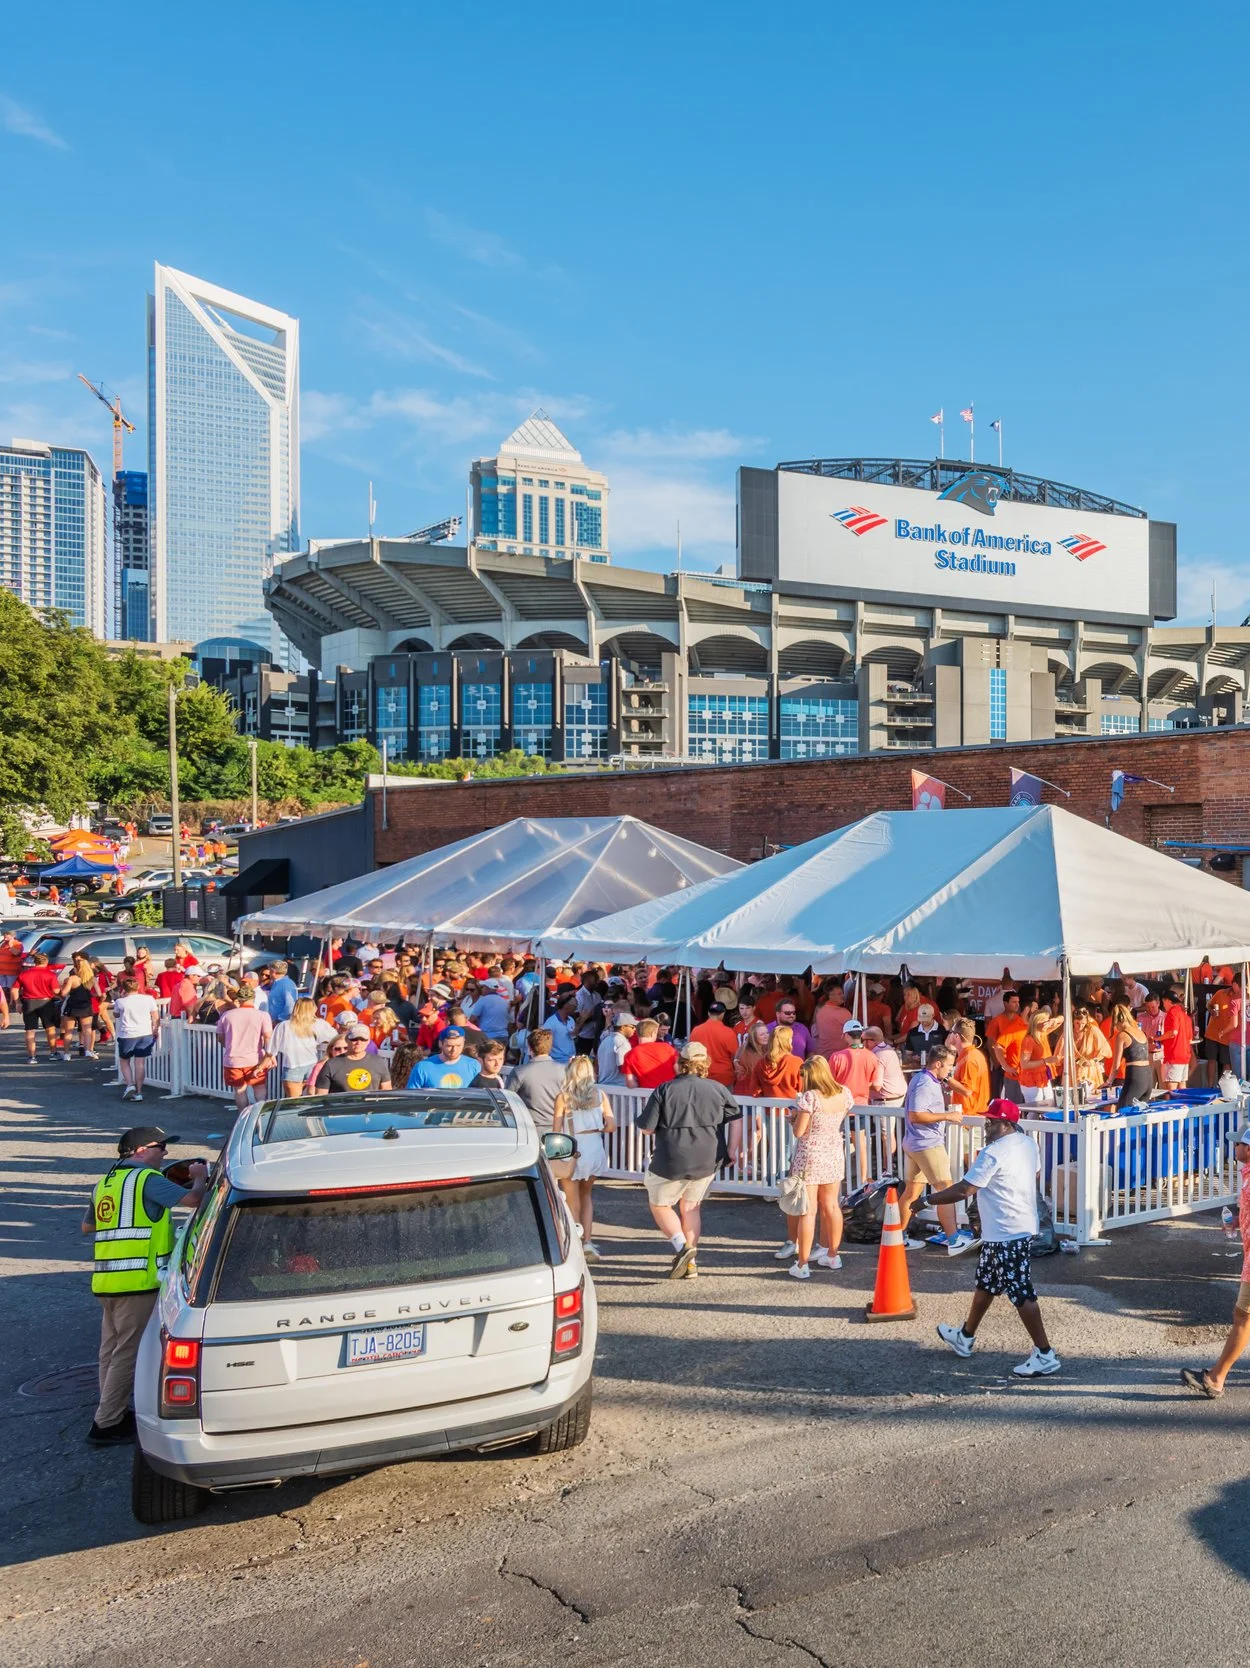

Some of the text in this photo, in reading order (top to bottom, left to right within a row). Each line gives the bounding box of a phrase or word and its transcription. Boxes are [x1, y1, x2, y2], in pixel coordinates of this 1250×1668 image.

[895, 518, 1052, 555] Bank of America
[935, 549, 1016, 576] Stadium
[276, 1294, 493, 1328] RANGE ROVER
[351, 1330, 422, 1356] TJA-8205
